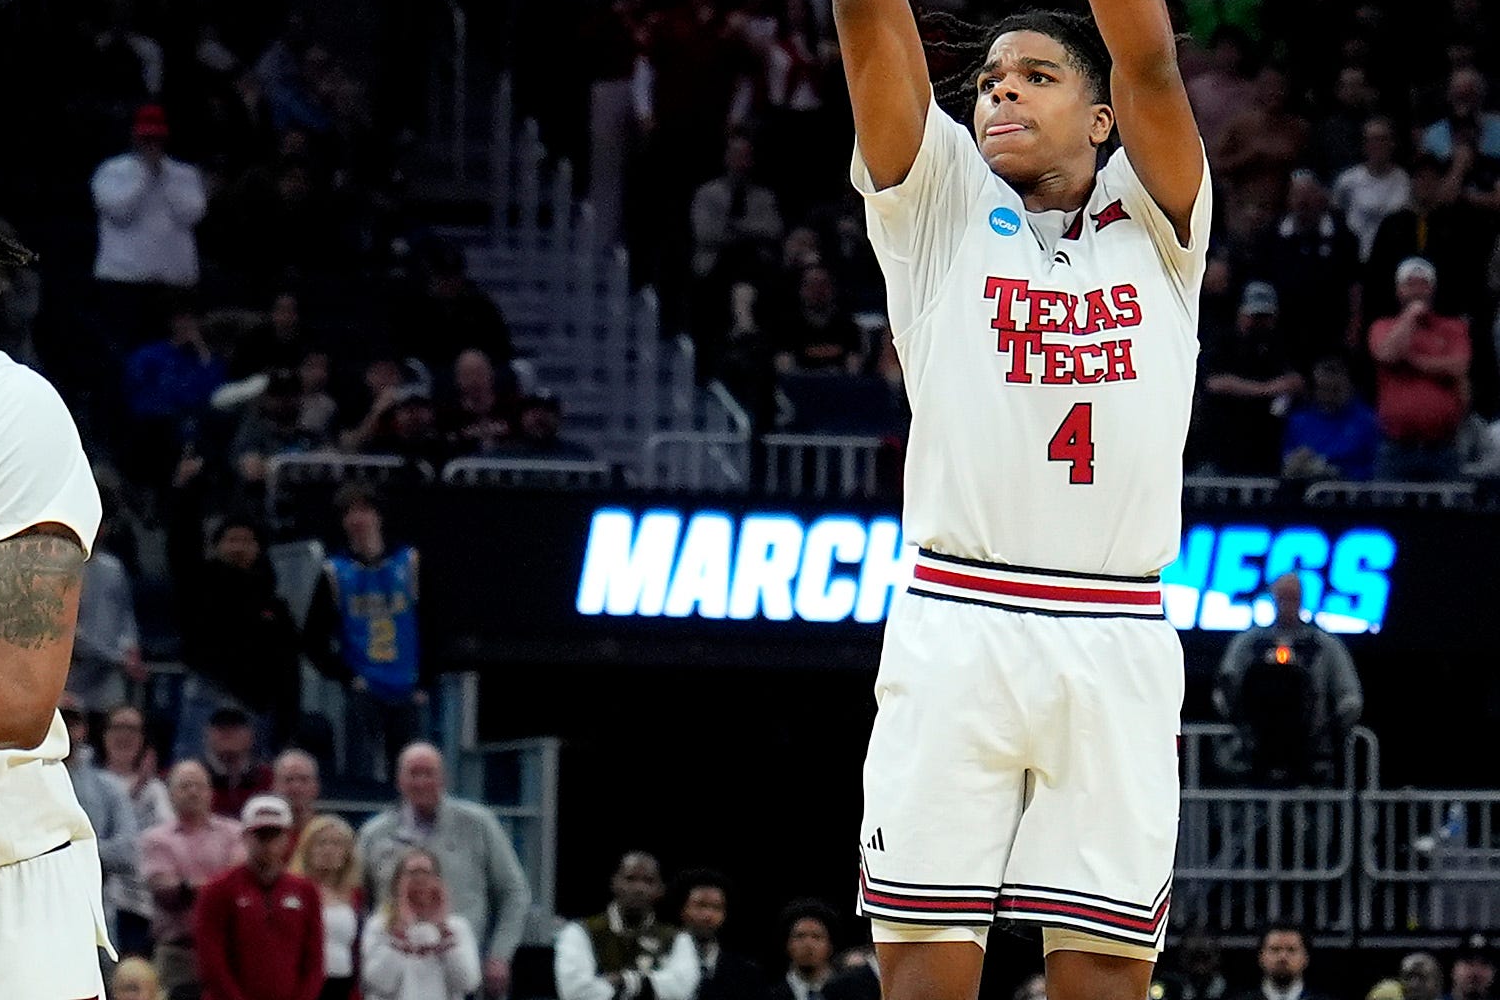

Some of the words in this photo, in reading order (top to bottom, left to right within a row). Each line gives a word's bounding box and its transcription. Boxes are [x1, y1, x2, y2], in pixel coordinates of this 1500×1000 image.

[983, 275, 1143, 335] TEXAS
[997, 330, 1137, 385] TECH
[1048, 402, 1094, 484] 4
[577, 510, 903, 623] MARCH
[1160, 527, 1397, 634] NESS
